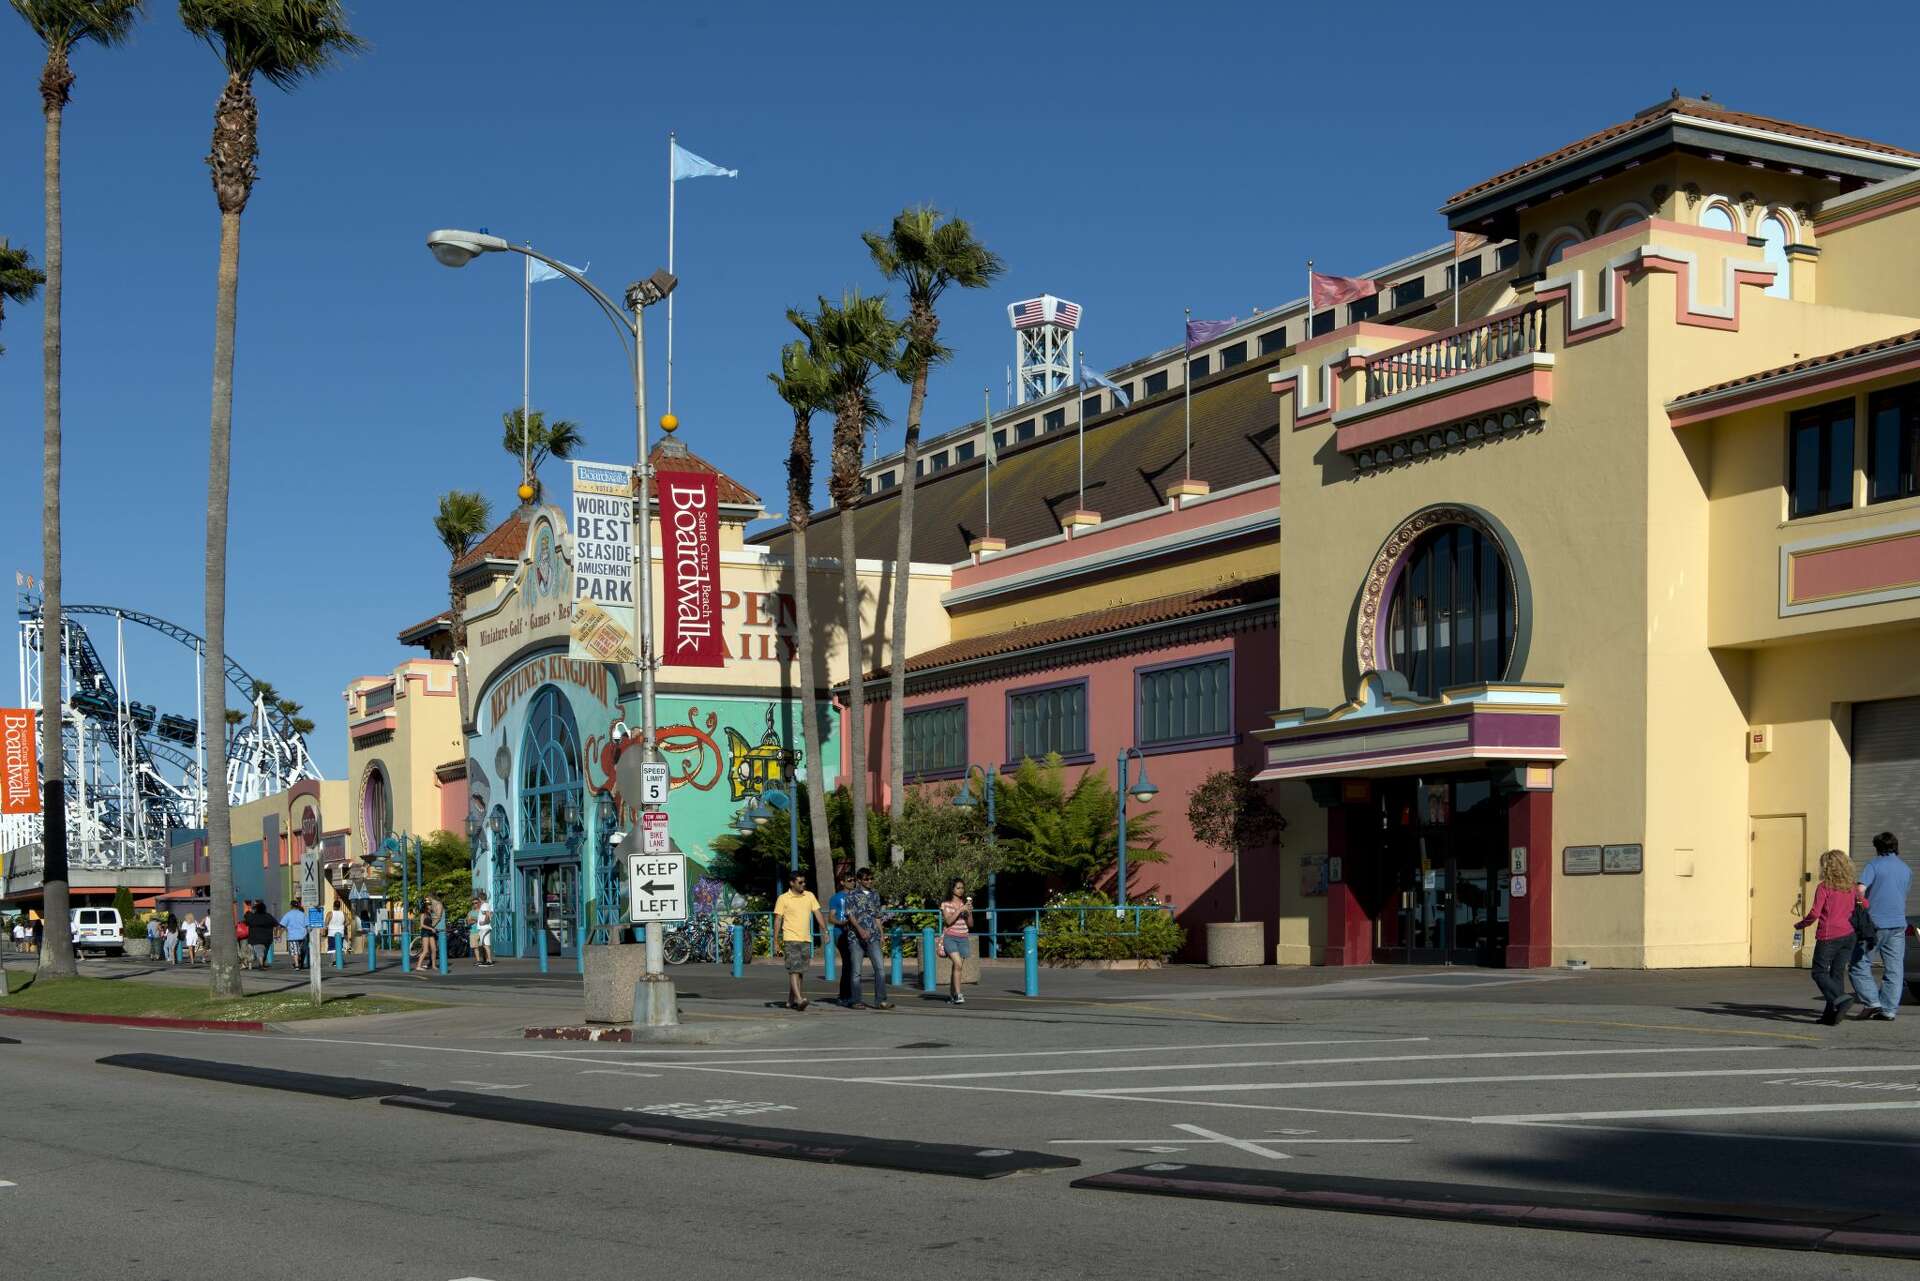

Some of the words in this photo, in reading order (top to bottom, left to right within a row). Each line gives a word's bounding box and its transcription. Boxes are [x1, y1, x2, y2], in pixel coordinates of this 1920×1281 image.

[576, 497, 630, 518] WORLD'S
[577, 516, 630, 542] BEST
[699, 511, 707, 540] Santa
[577, 542, 632, 563] SEASIDE
[699, 543, 710, 572] Cruz
[577, 562, 632, 577] AMUSEMENT
[671, 483, 711, 654] Boardwalk
[576, 577, 633, 602] PARK
[701, 585, 712, 618] Beach
[480, 627, 508, 647] Miniature
[509, 617, 523, 637] Golf
[530, 612, 551, 630] Games
[491, 657, 546, 734] NEPTUNE'S
[549, 656, 608, 708] KINGDOM
[4, 714, 31, 808] Boardwalk
[643, 767, 666, 775] SPEED
[650, 785, 659, 799] 5
[649, 839, 665, 847] LANE
[636, 863, 678, 876] KEEP
[640, 899, 679, 912] LEFT
